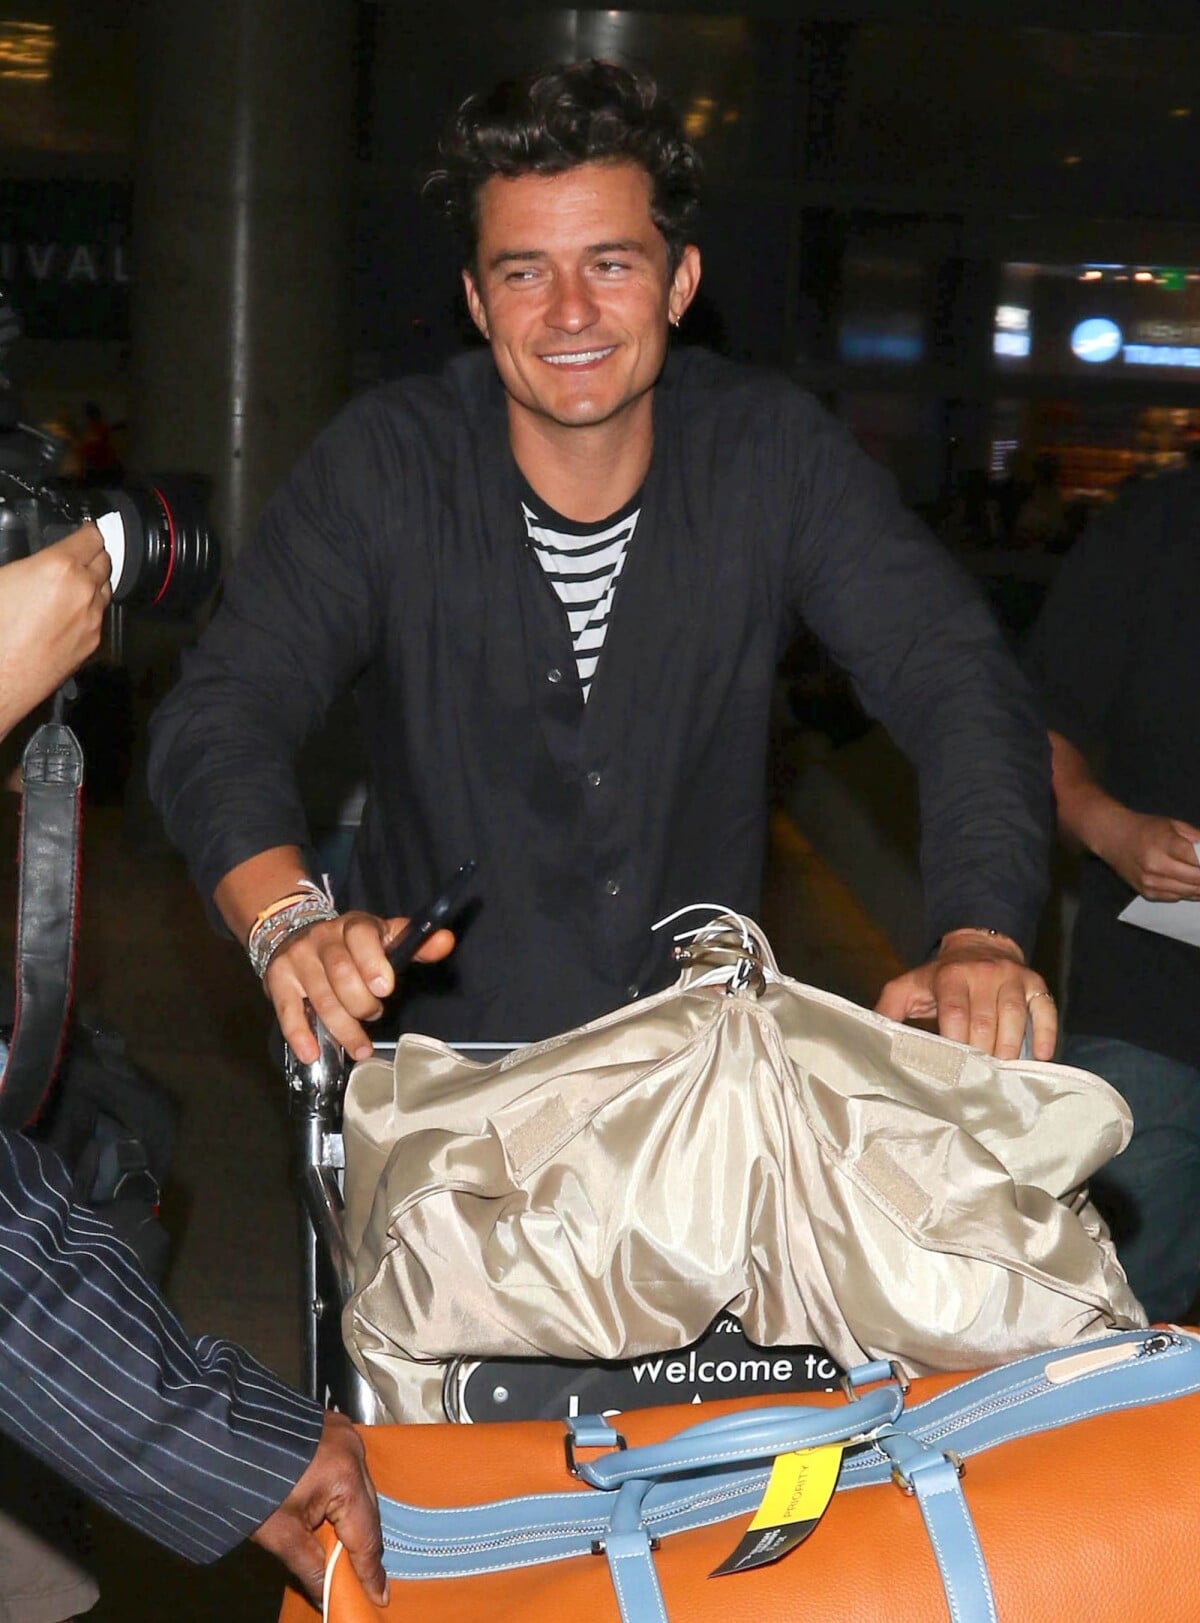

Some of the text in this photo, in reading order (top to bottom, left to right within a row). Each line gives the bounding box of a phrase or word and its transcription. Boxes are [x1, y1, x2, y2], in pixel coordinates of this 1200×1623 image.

[632, 1351, 837, 1384] Welcome to
[783, 1465, 809, 1518] PRIORITY
